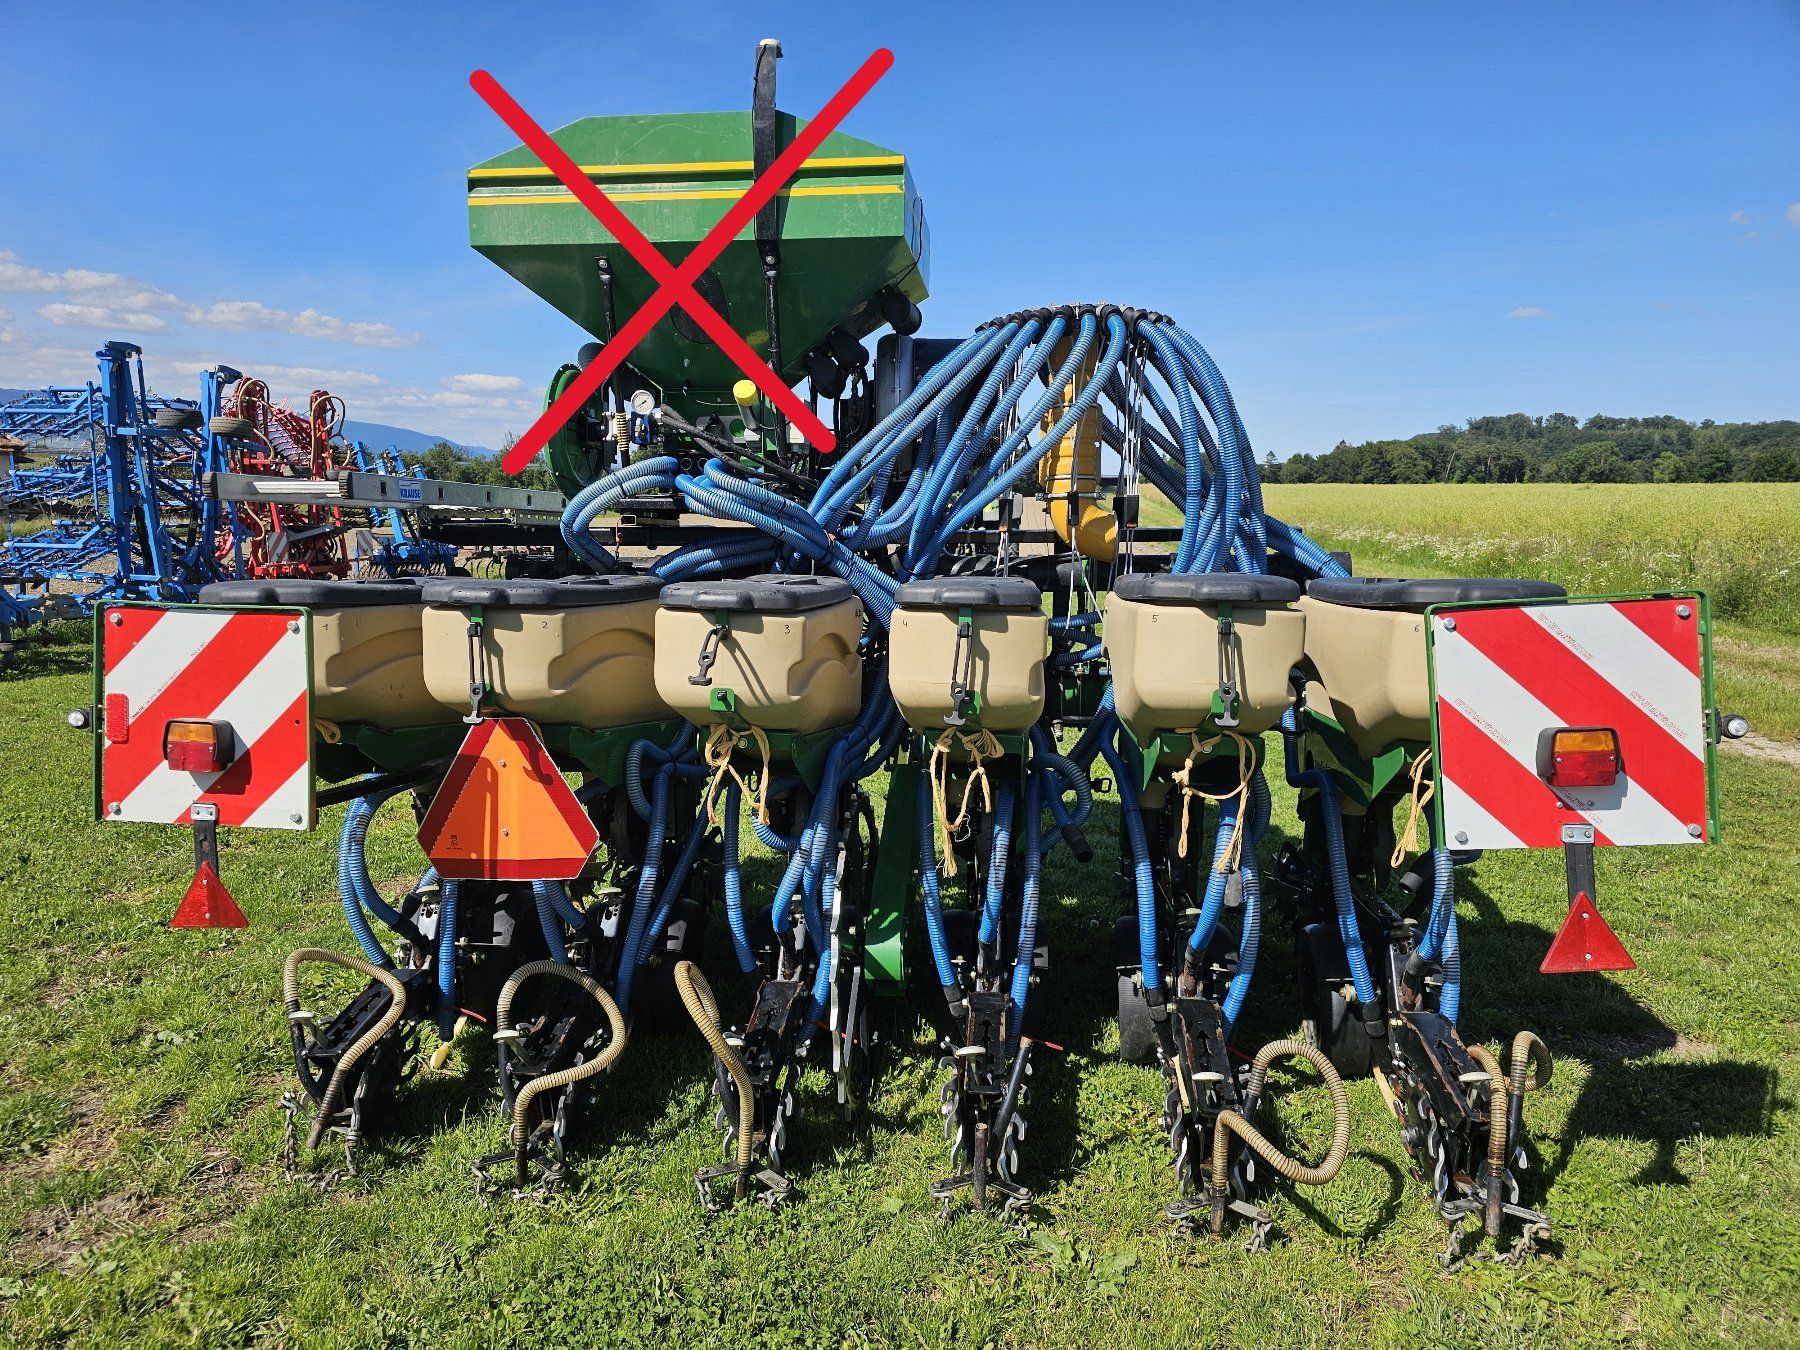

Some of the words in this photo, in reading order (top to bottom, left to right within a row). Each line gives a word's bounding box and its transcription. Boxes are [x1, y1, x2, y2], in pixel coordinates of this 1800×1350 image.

[400, 488, 422, 499] KRAUSE
[1151, 614, 1159, 623] 5
[322, 623, 329, 631] 1
[542, 620, 548, 629] 2
[902, 619, 908, 628] 4
[784, 624, 791, 635] 3
[1414, 624, 1420, 633] 6
